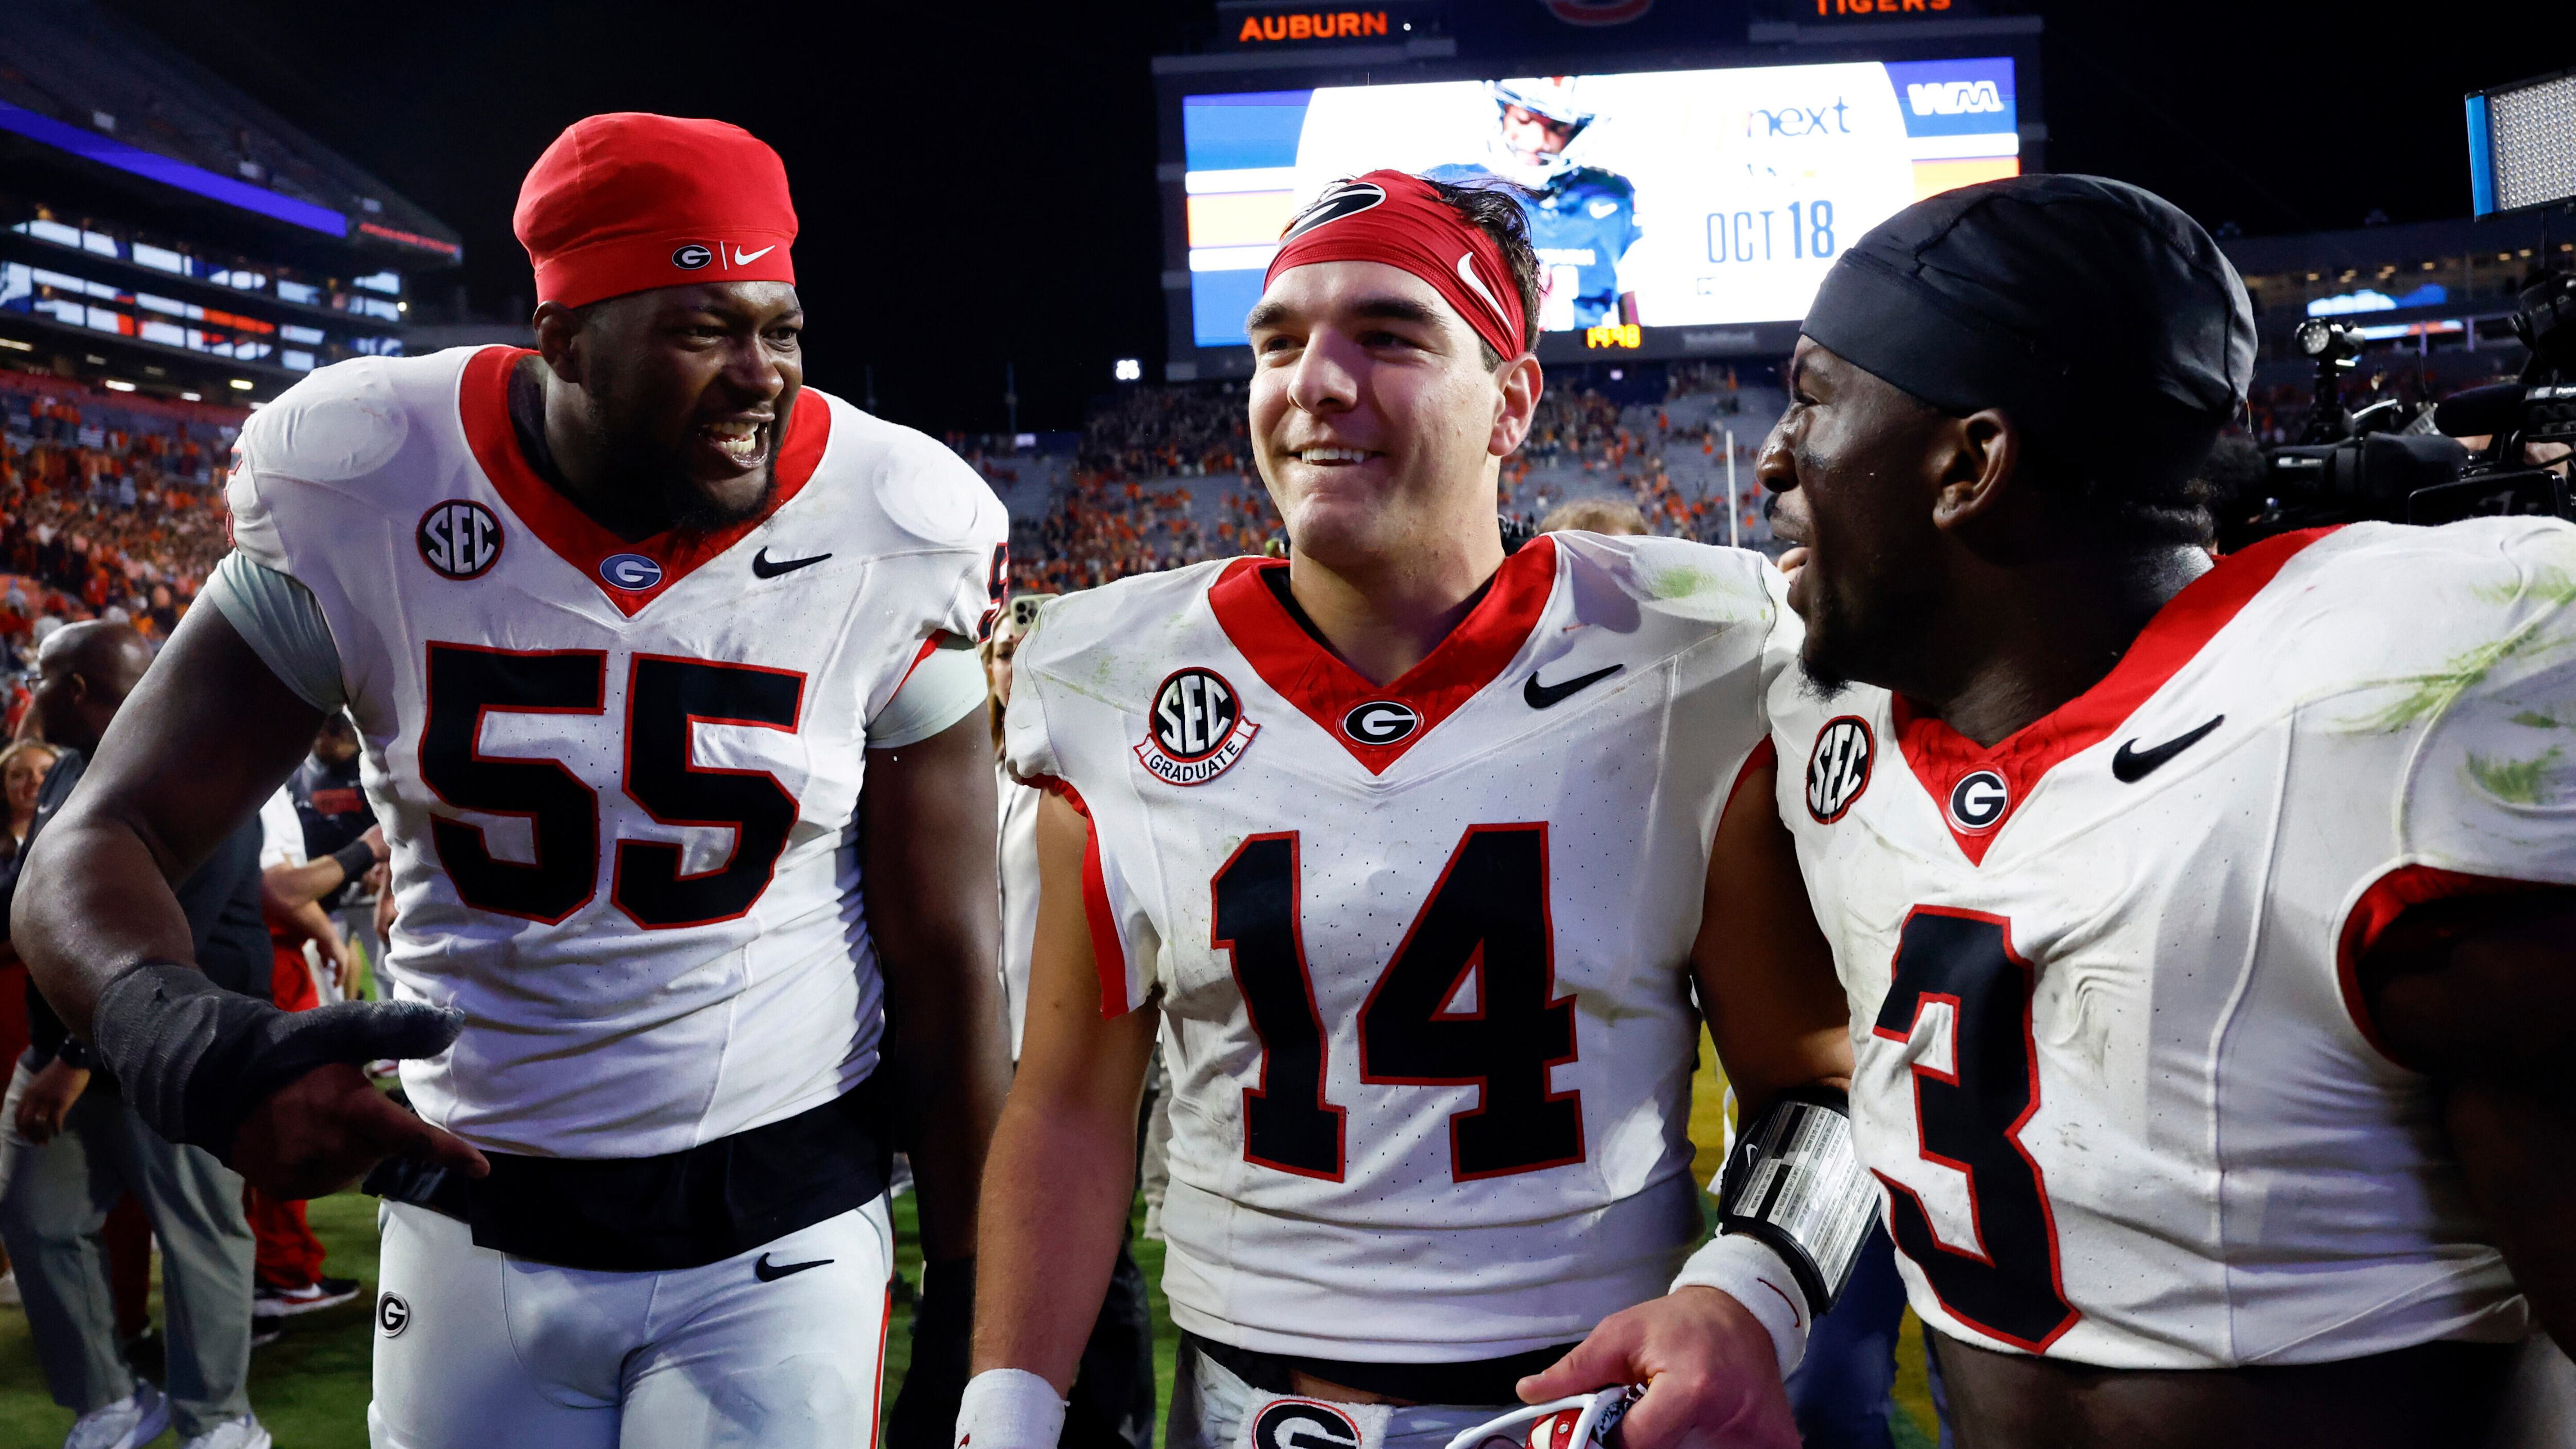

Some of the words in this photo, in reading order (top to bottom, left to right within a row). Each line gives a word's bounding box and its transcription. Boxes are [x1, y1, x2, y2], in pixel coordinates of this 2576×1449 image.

[1239, 11, 1387, 42] AUBURN
[1747, 96, 1850, 137] next
[1706, 210, 1775, 263] OCT
[1788, 200, 1835, 259] 18
[425, 505, 496, 575] SEC
[1157, 675, 1229, 754] SEC
[418, 640, 808, 931] 55
[1149, 741, 1240, 782] GRADUATE
[1809, 723, 1867, 814] SEC
[1210, 821, 1586, 1183] 14
[1870, 903, 2082, 1354] 3
